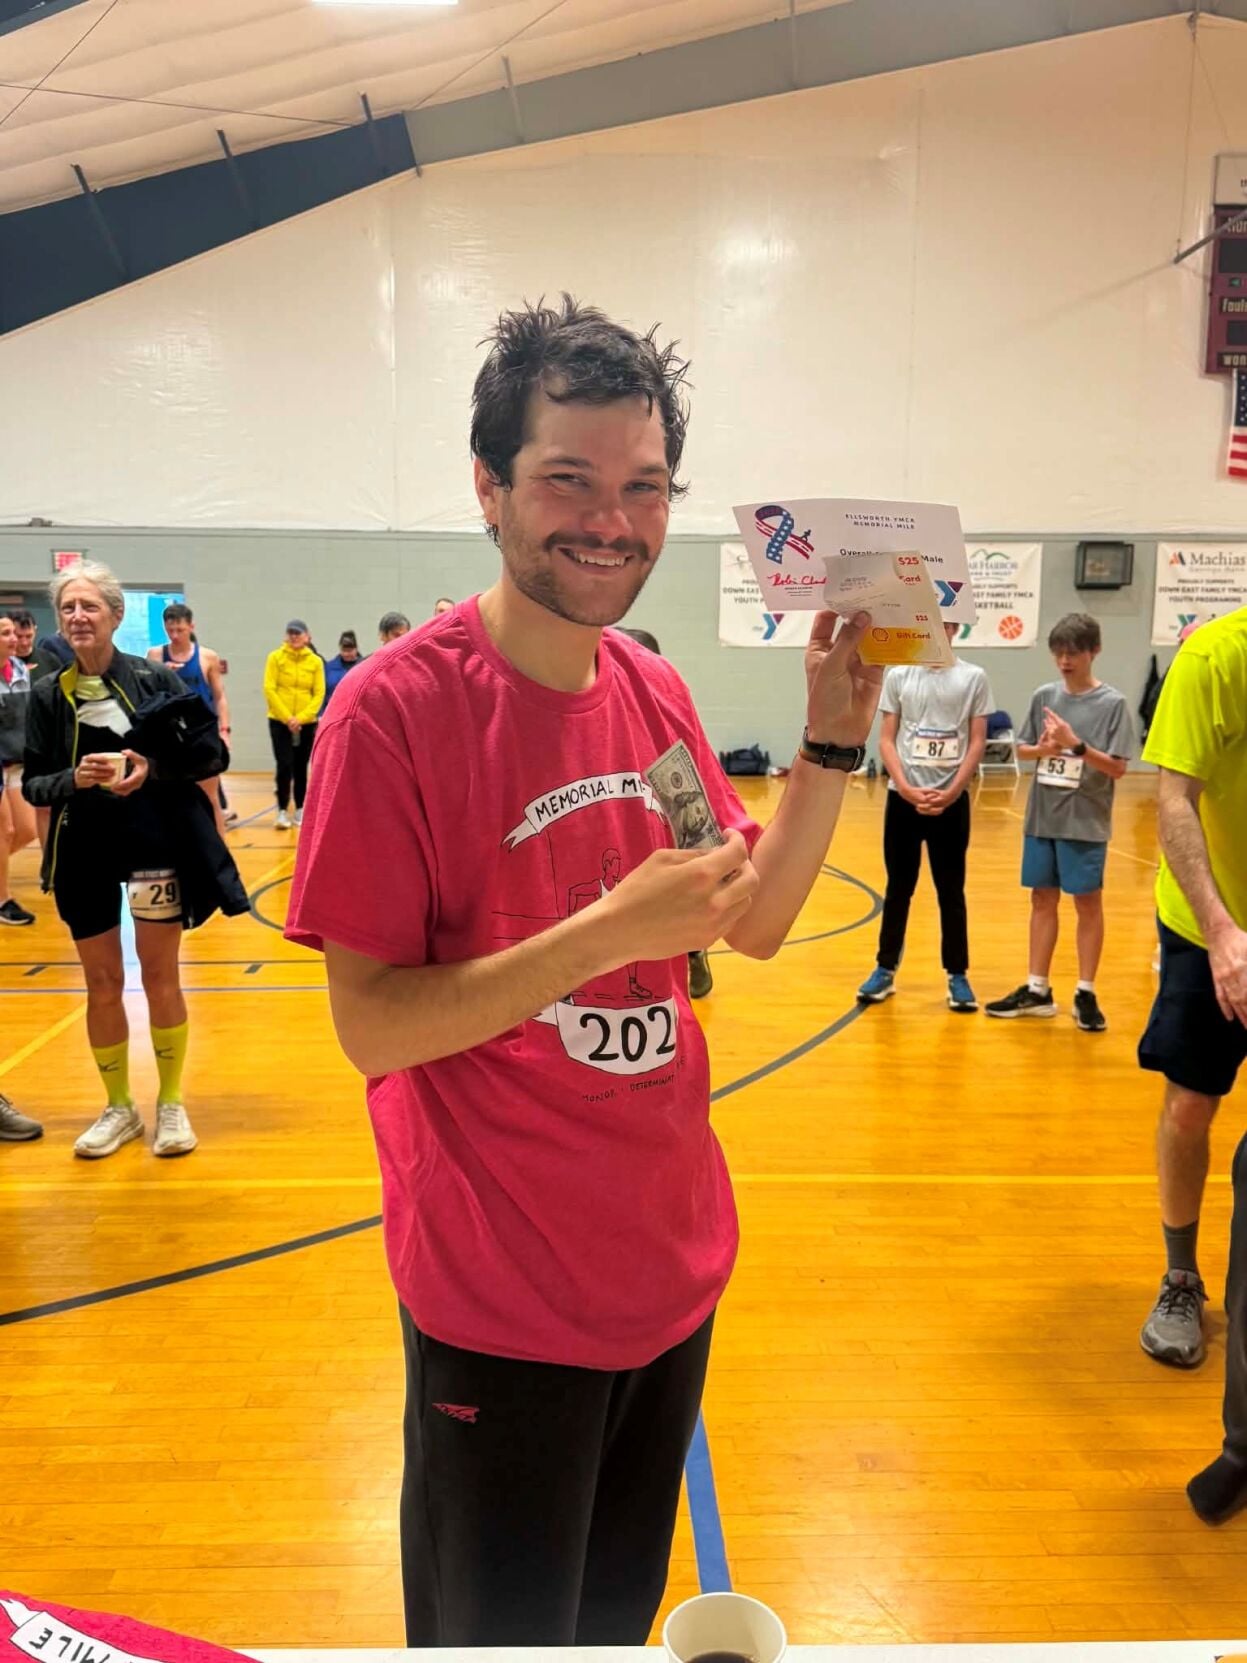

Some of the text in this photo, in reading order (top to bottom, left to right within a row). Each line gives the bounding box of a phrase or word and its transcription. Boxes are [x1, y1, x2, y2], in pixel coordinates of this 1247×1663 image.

[1190, 551, 1245, 566] Machias
[974, 601, 1014, 609] SKETBALL
[896, 631, 910, 639] Gift
[928, 741, 945, 757] 87
[1047, 757, 1066, 775] 53
[535, 780, 614, 823] MEMORIAL
[149, 882, 176, 905] 29
